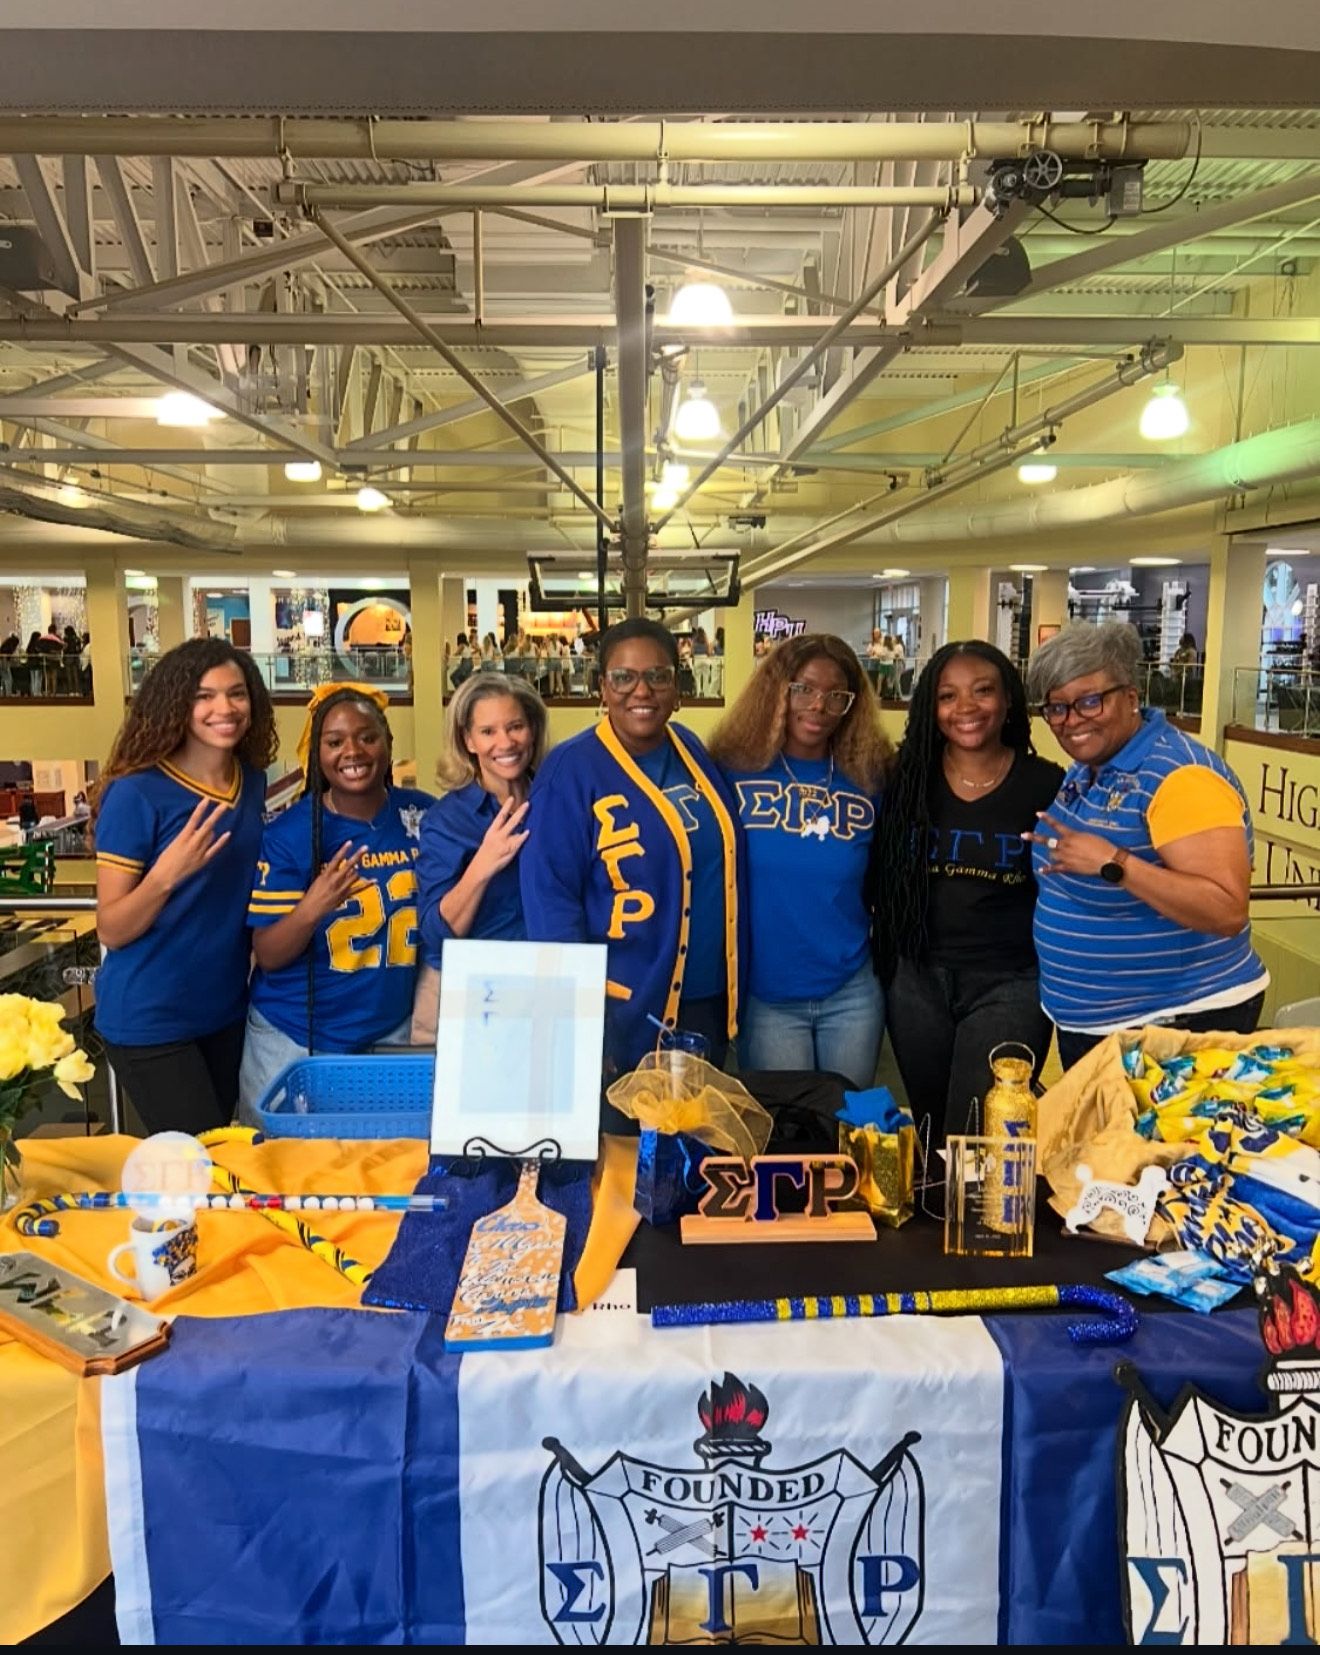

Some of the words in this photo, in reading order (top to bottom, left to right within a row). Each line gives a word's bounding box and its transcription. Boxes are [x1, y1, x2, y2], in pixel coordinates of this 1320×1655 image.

[1259, 763, 1320, 830] HIG
[361, 850, 410, 869] GAMMA
[944, 862, 998, 881] Gamma
[641, 1470, 825, 1503] FOUNDED
